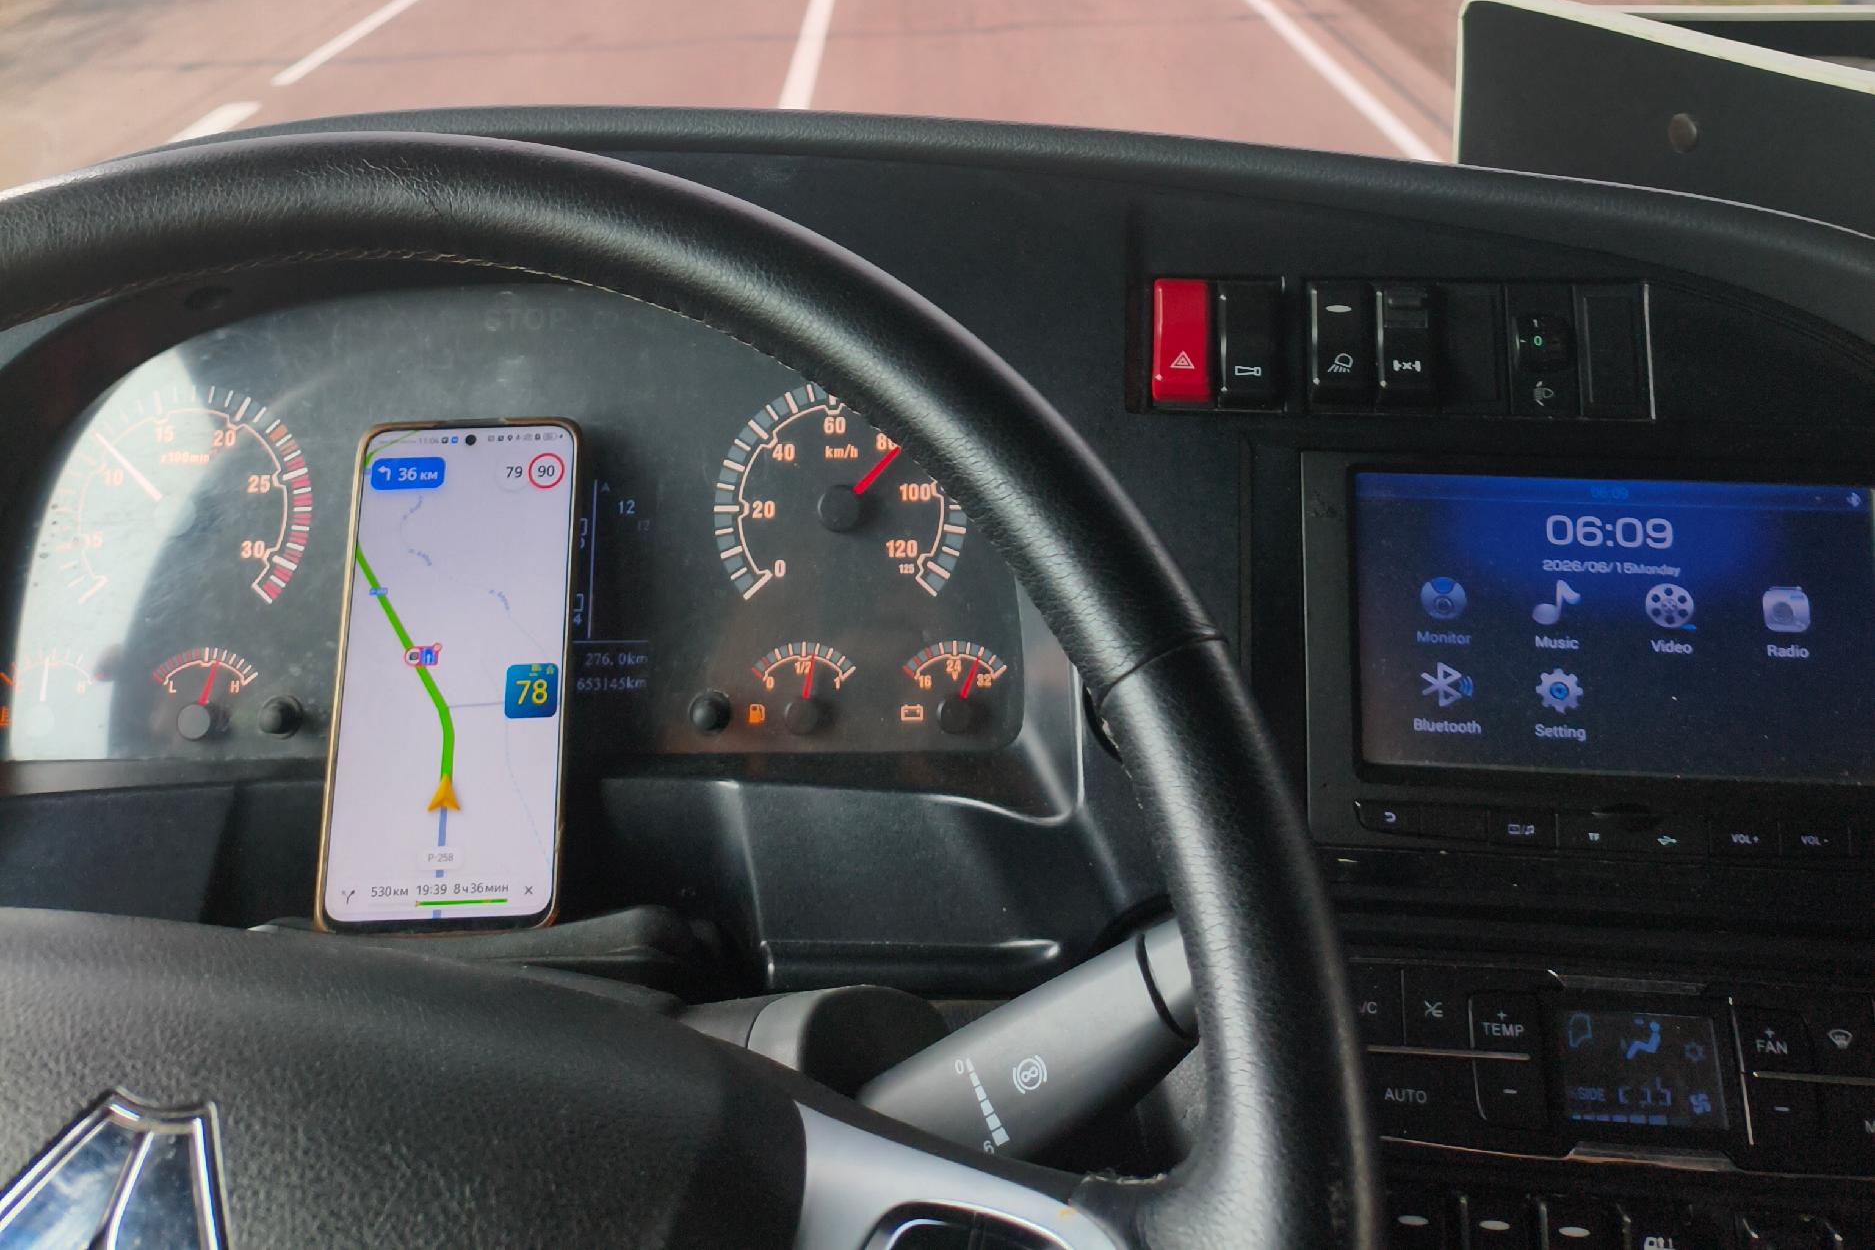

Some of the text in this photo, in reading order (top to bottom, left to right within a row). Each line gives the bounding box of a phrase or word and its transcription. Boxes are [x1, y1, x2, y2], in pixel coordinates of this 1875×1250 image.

[1533, 335, 1543, 346] 0
[823, 417, 846, 434] 60
[155, 425, 174, 443] 15
[213, 429, 236, 447] 20
[772, 443, 796, 461] 40
[824, 445, 859, 460] km/h
[398, 467, 438, 481] 36 км
[506, 465, 523, 478] 79
[537, 464, 555, 477] 90
[248, 475, 270, 493] 25
[900, 484, 930, 501] 100
[619, 500, 635, 514] 12
[752, 502, 775, 519] 20
[1546, 514, 1673, 549] 06:09
[241, 541, 265, 558] 30
[886, 540, 917, 557] 120
[774, 560, 786, 577] 0
[1416, 631, 1472, 645] Monitor
[1535, 635, 1579, 650] Music
[1650, 640, 1693, 655] Video
[1767, 644, 1809, 659] Radio
[947, 660, 961, 672] 24
[169, 681, 177, 693] L
[230, 680, 240, 693] H
[766, 675, 774, 689] 0
[834, 677, 840, 689] 1
[919, 675, 932, 687] 16
[977, 674, 992, 687] 32
[516, 679, 548, 705] 78
[1413, 718, 1481, 735] Bluetooth
[1535, 724, 1586, 741] Setting
[416, 884, 447, 895] 19:39
[1483, 1022, 1524, 1037] TEMP
[1757, 1039, 1788, 1054] FAN
[1384, 1087, 1427, 1104] AUTO
